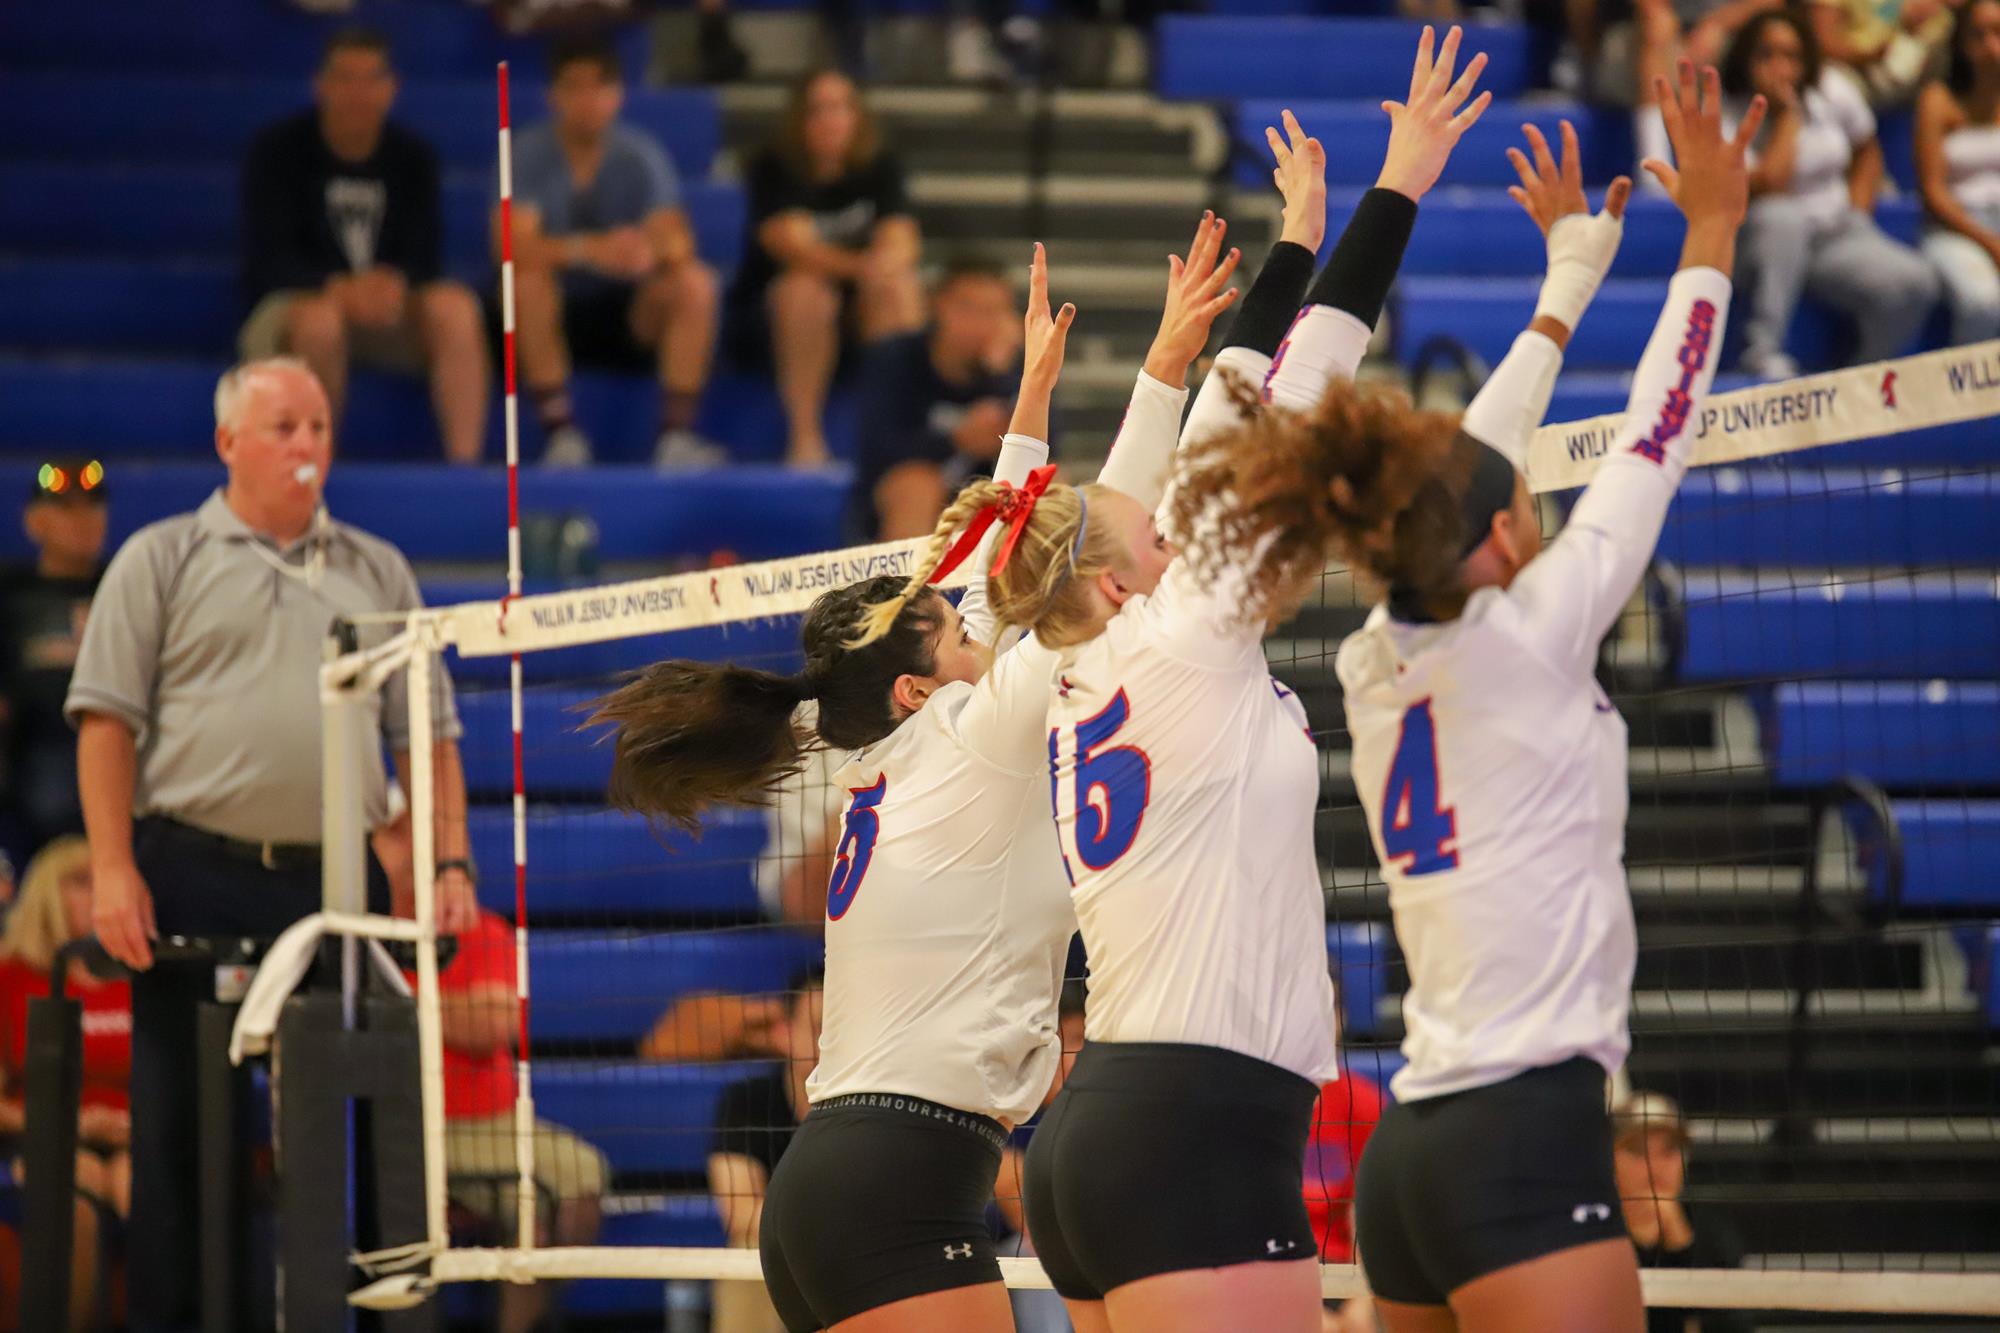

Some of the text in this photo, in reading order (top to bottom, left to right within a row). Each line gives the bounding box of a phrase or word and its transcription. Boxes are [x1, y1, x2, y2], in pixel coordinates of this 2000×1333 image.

[1945, 352, 2000, 394] WILL
[1723, 387, 1837, 433] UNIVERSITY
[842, 549, 914, 584] UNIVERSITY
[1382, 695, 1459, 877] 4
[858, 1094, 930, 1116] ARMOUR
